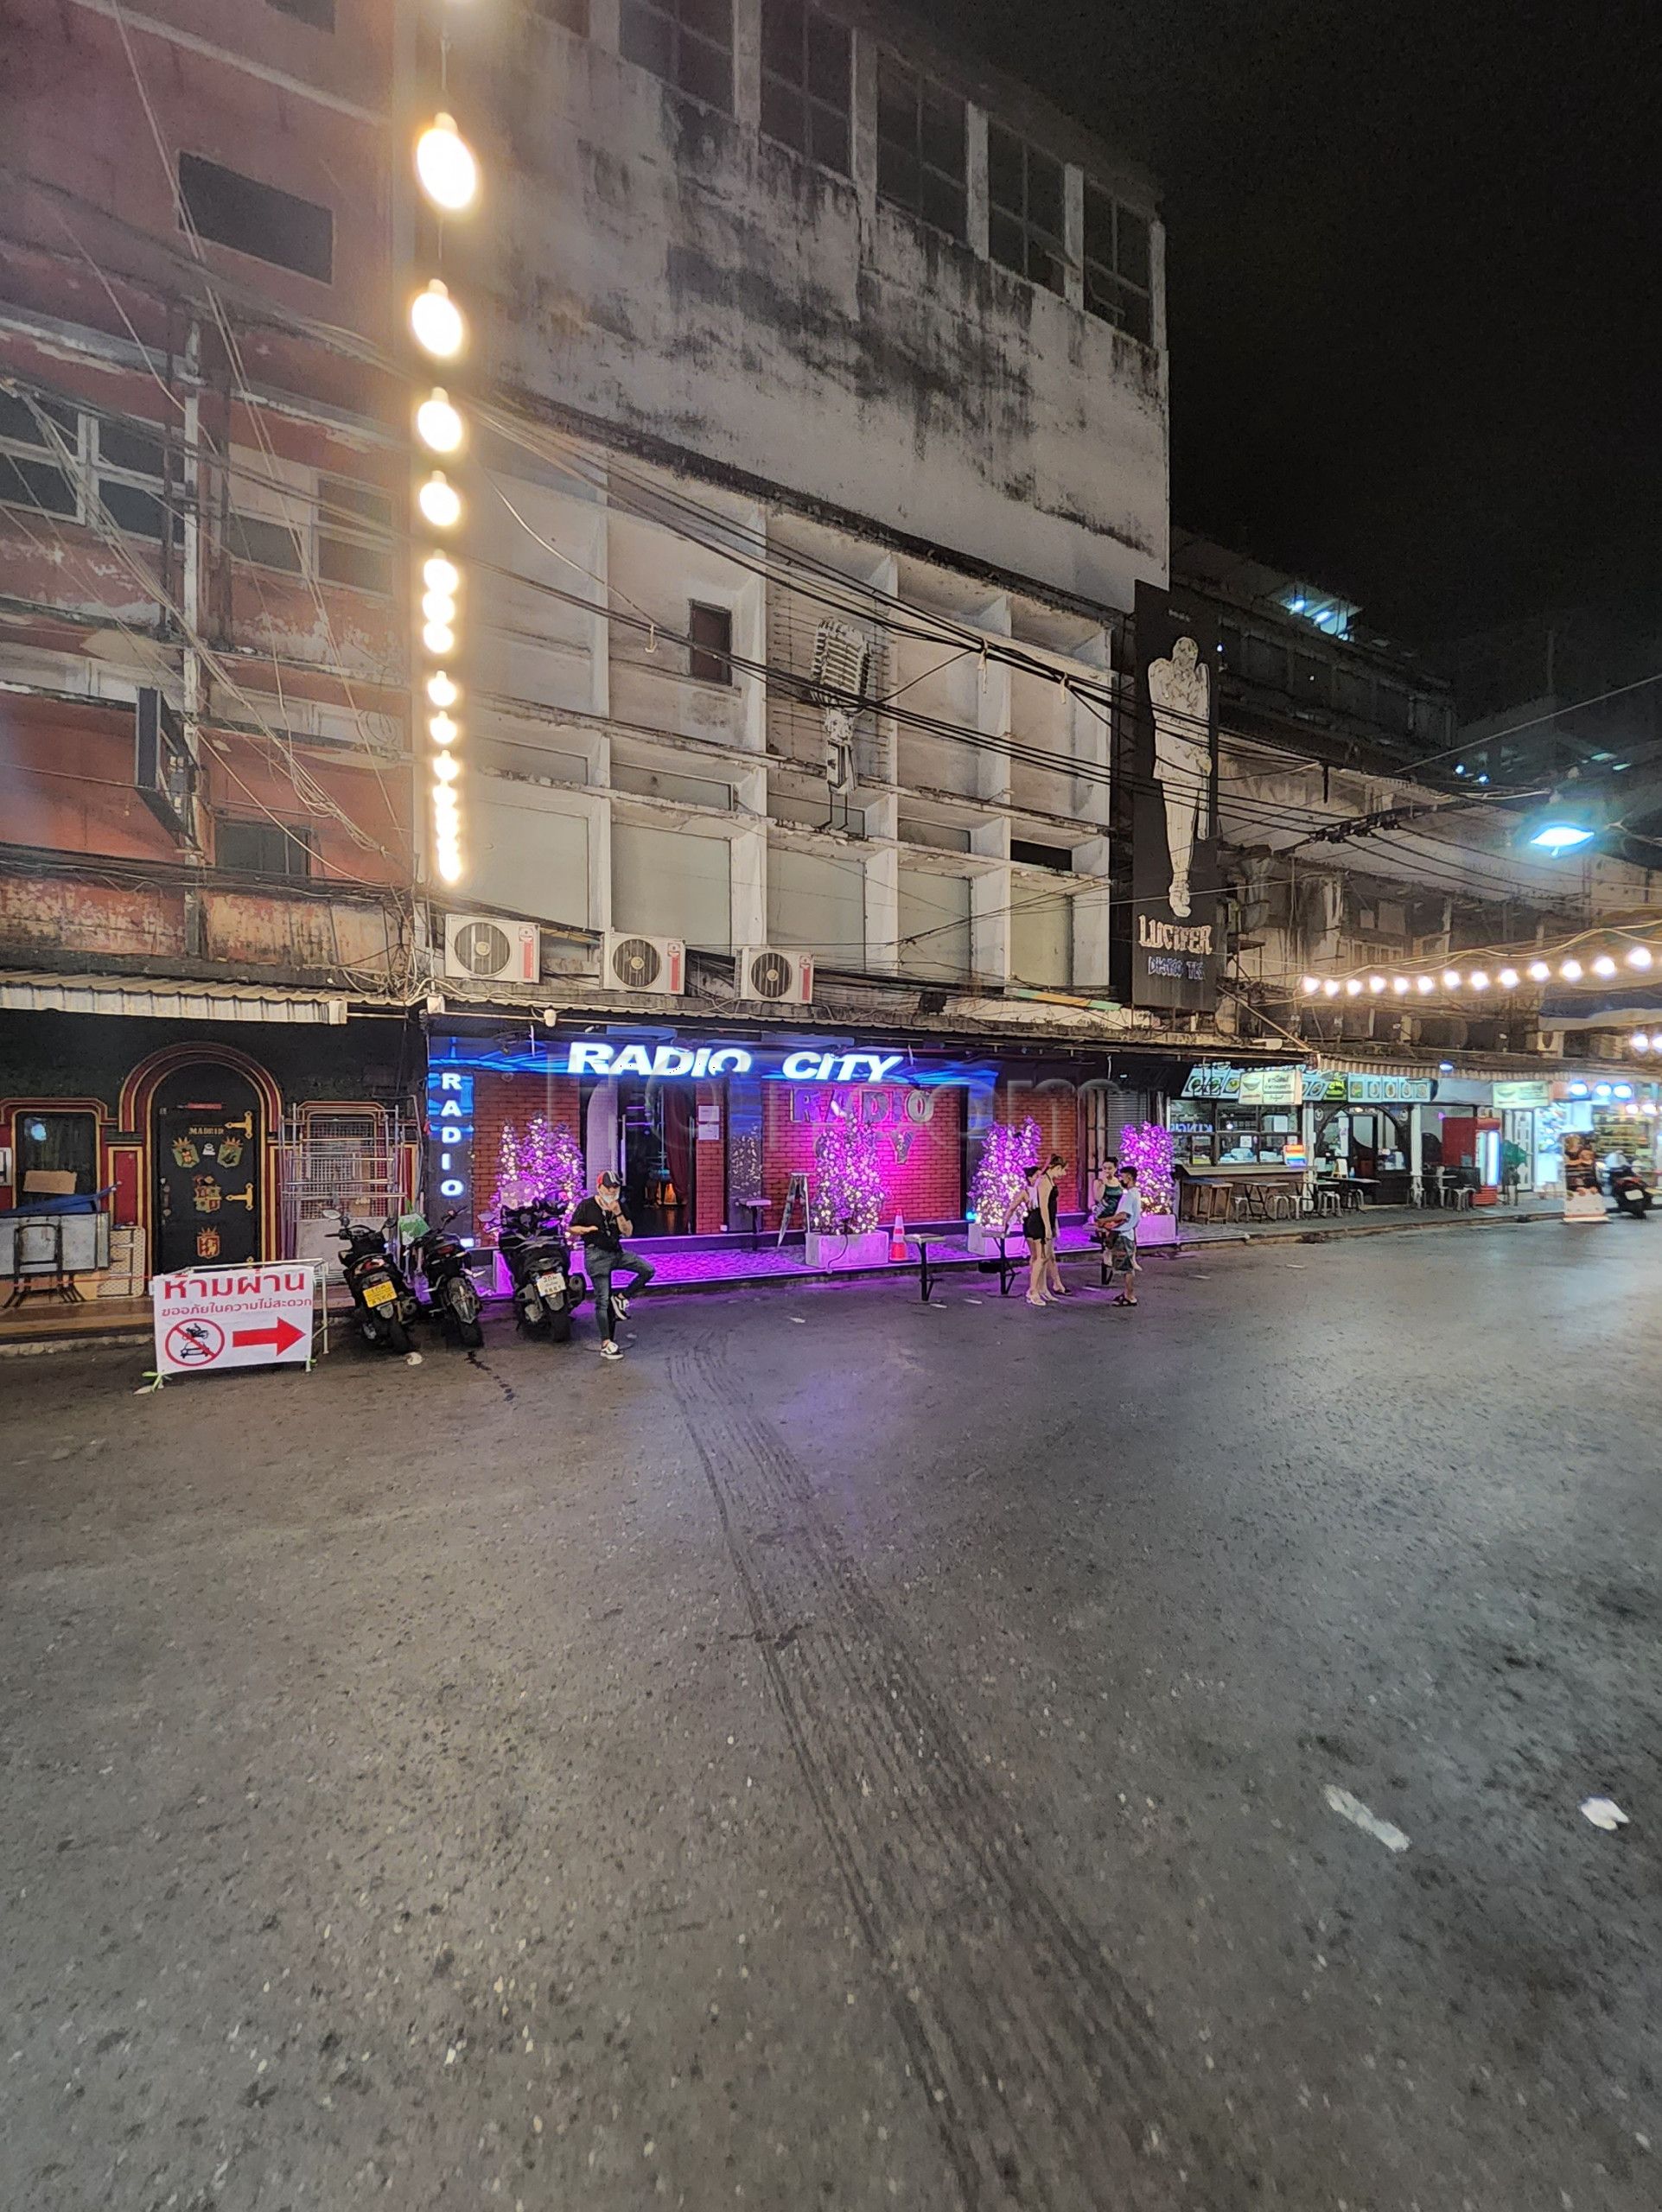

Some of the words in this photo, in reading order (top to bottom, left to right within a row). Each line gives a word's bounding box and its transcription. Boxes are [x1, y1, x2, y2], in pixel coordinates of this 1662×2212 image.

[1138, 915, 1212, 955] LUCIFER
[567, 1042, 750, 1077] RADIO
[782, 1052, 902, 1083] CITY
[441, 1072, 464, 1197] RADIO
[164, 1270, 305, 1300] ห้ามผ่าน
[162, 1298, 312, 1317] ขออภัยในความไม่สะดวก
